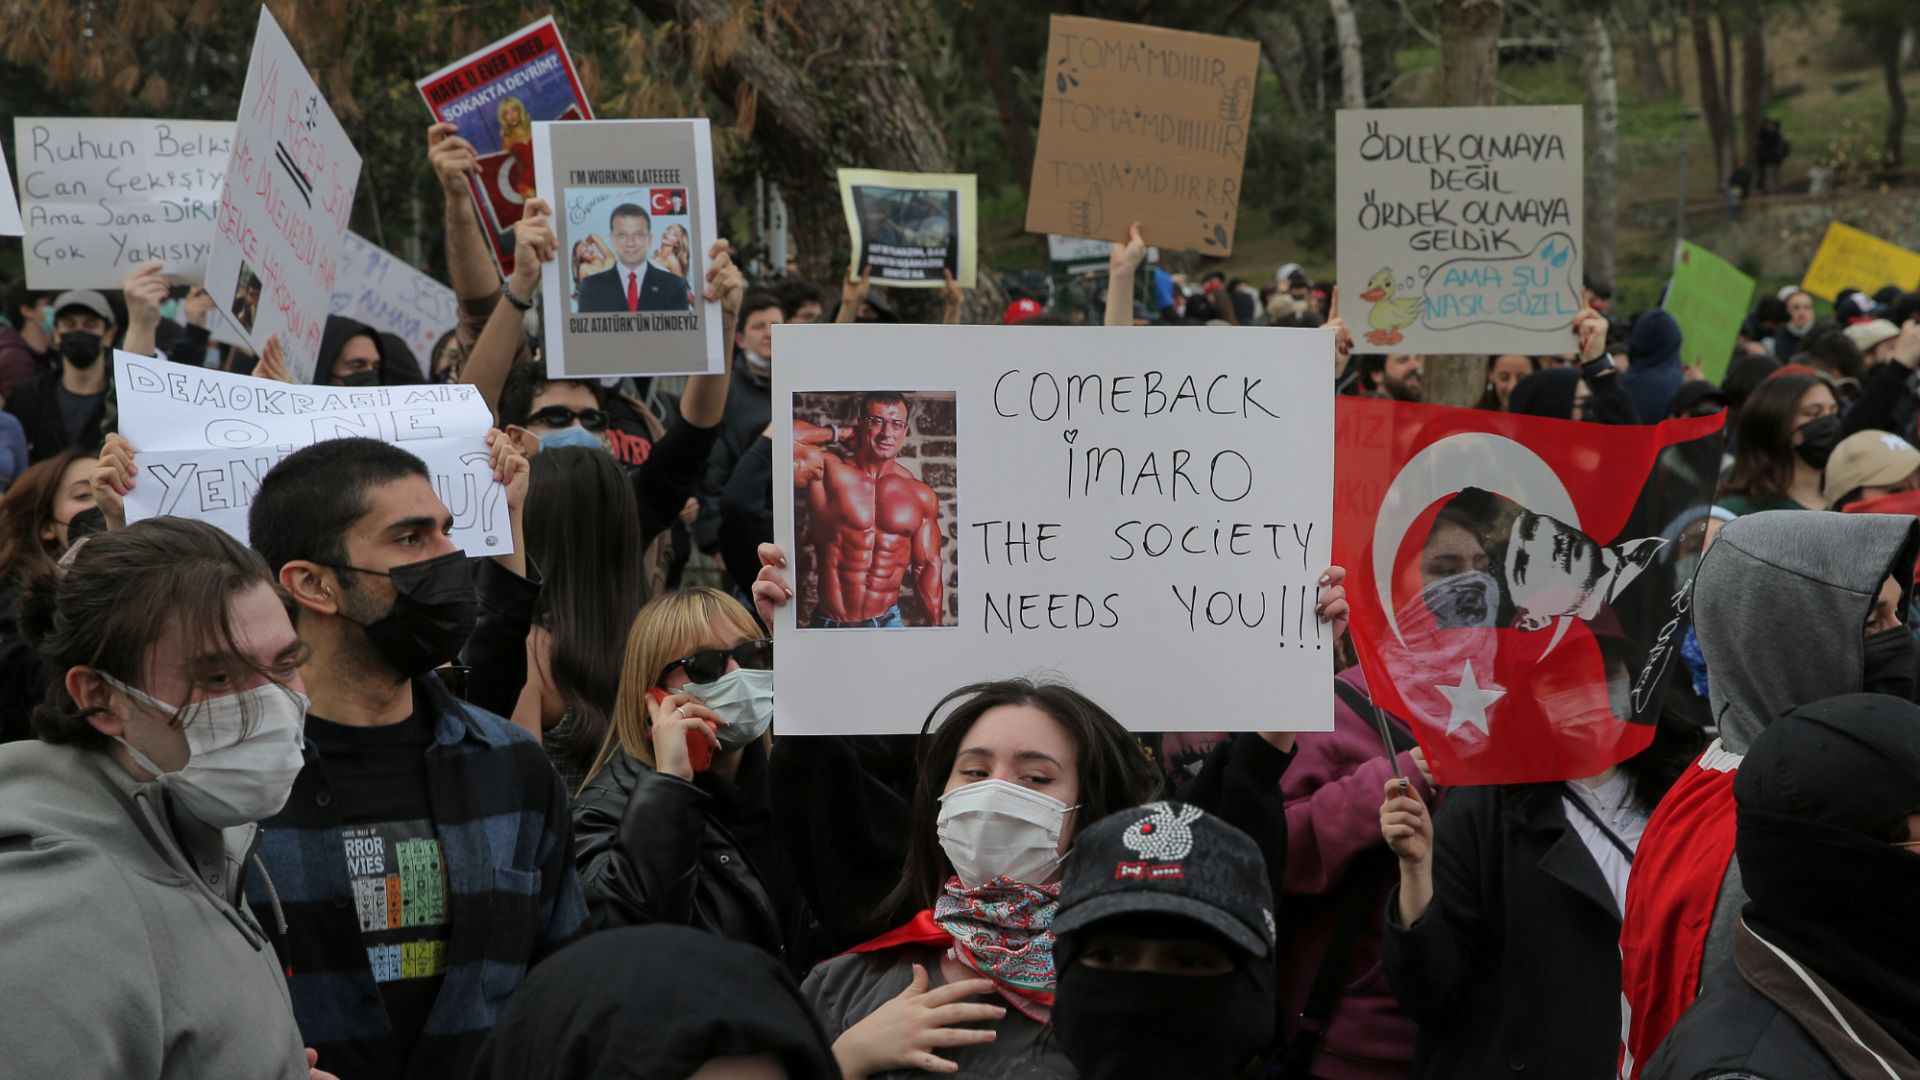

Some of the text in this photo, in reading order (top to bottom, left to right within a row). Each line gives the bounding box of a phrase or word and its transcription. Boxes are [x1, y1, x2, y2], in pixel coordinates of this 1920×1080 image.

[443, 53, 559, 122] SOKAKTA DEVRİM?
[465, 69, 477, 87] U
[31, 124, 231, 164] Ruhun Belki
[1360, 120, 1565, 163] ÖDLEK OLMAYA
[24, 167, 223, 200] Can Çekişiy
[570, 170, 586, 185] I'M
[588, 169, 635, 184] WORKING
[1431, 164, 1517, 194] DEĞİL
[29, 204, 86, 228] Ama
[95, 197, 156, 227] Sana
[1358, 189, 1571, 230] ÖRDEK OLMAYA
[33, 236, 86, 266] Çok
[1409, 228, 1524, 253] GELDİK
[1444, 265, 1550, 288] AMA SU
[1425, 286, 1579, 321] NASIL GÜZEL
[570, 317, 589, 334] CUZ
[652, 312, 699, 332] İZİNDEYİZ
[127, 363, 391, 415] DEMOKRASİ
[994, 369, 1281, 421] COMEBACK
[205, 408, 443, 449] O NE
[972, 520, 1062, 565] THE
[984, 584, 1322, 650] NEEDS YOU!!!
